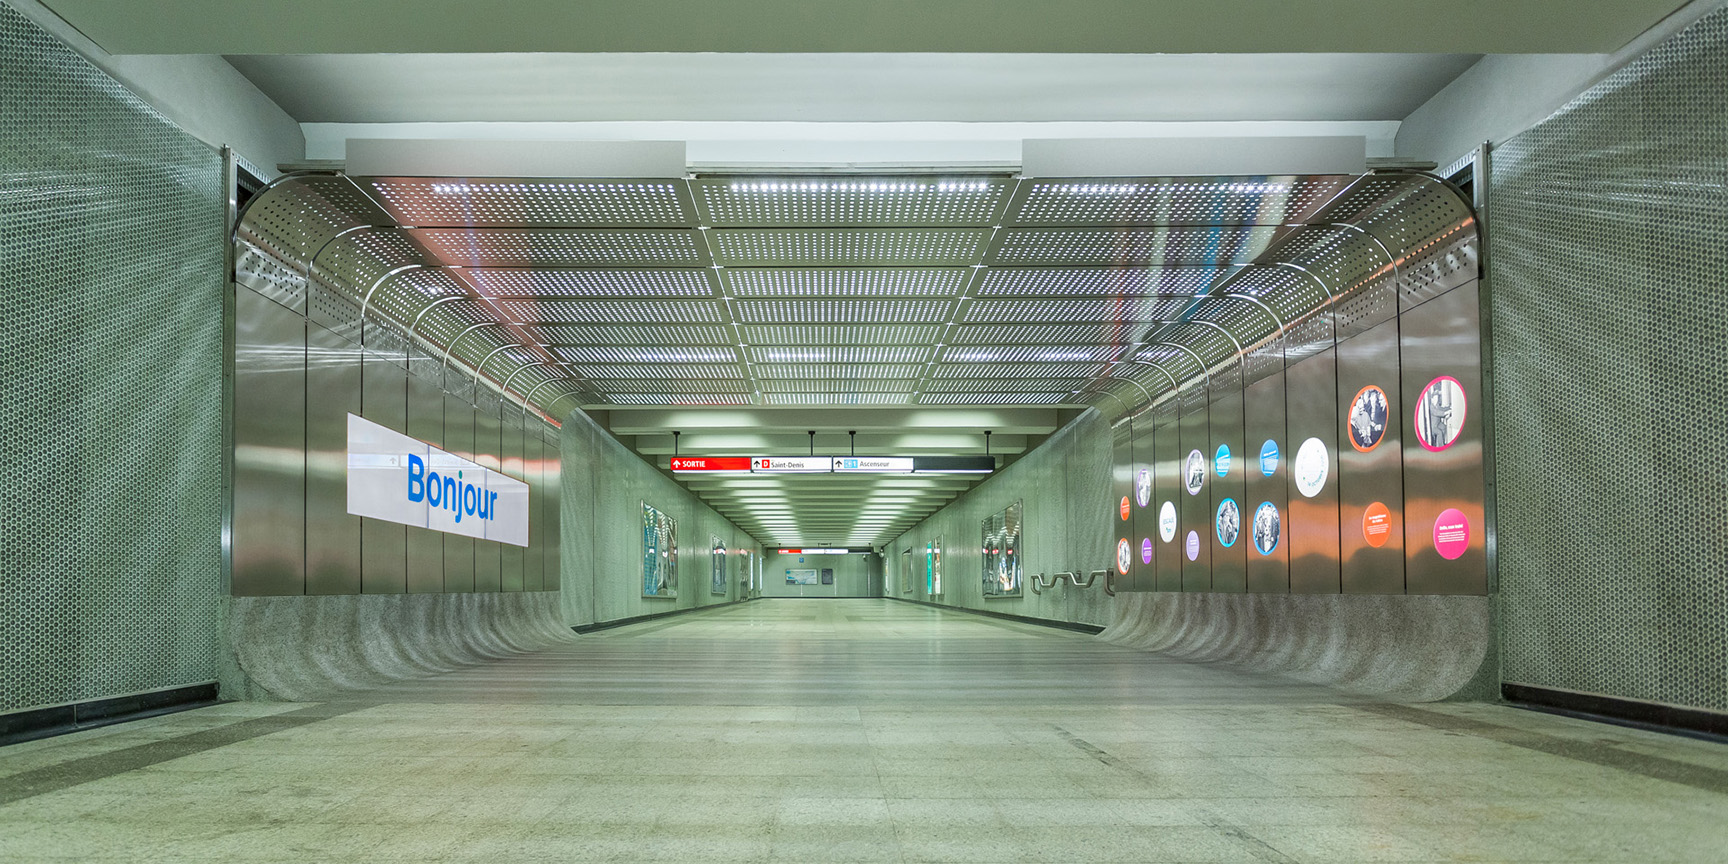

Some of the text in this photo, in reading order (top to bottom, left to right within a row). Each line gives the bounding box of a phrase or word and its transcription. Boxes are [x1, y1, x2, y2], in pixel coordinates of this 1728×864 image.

[682, 460, 706, 468] SORTIE
[771, 460, 805, 468] Saint-Denis
[408, 453, 498, 524] Bonjour
